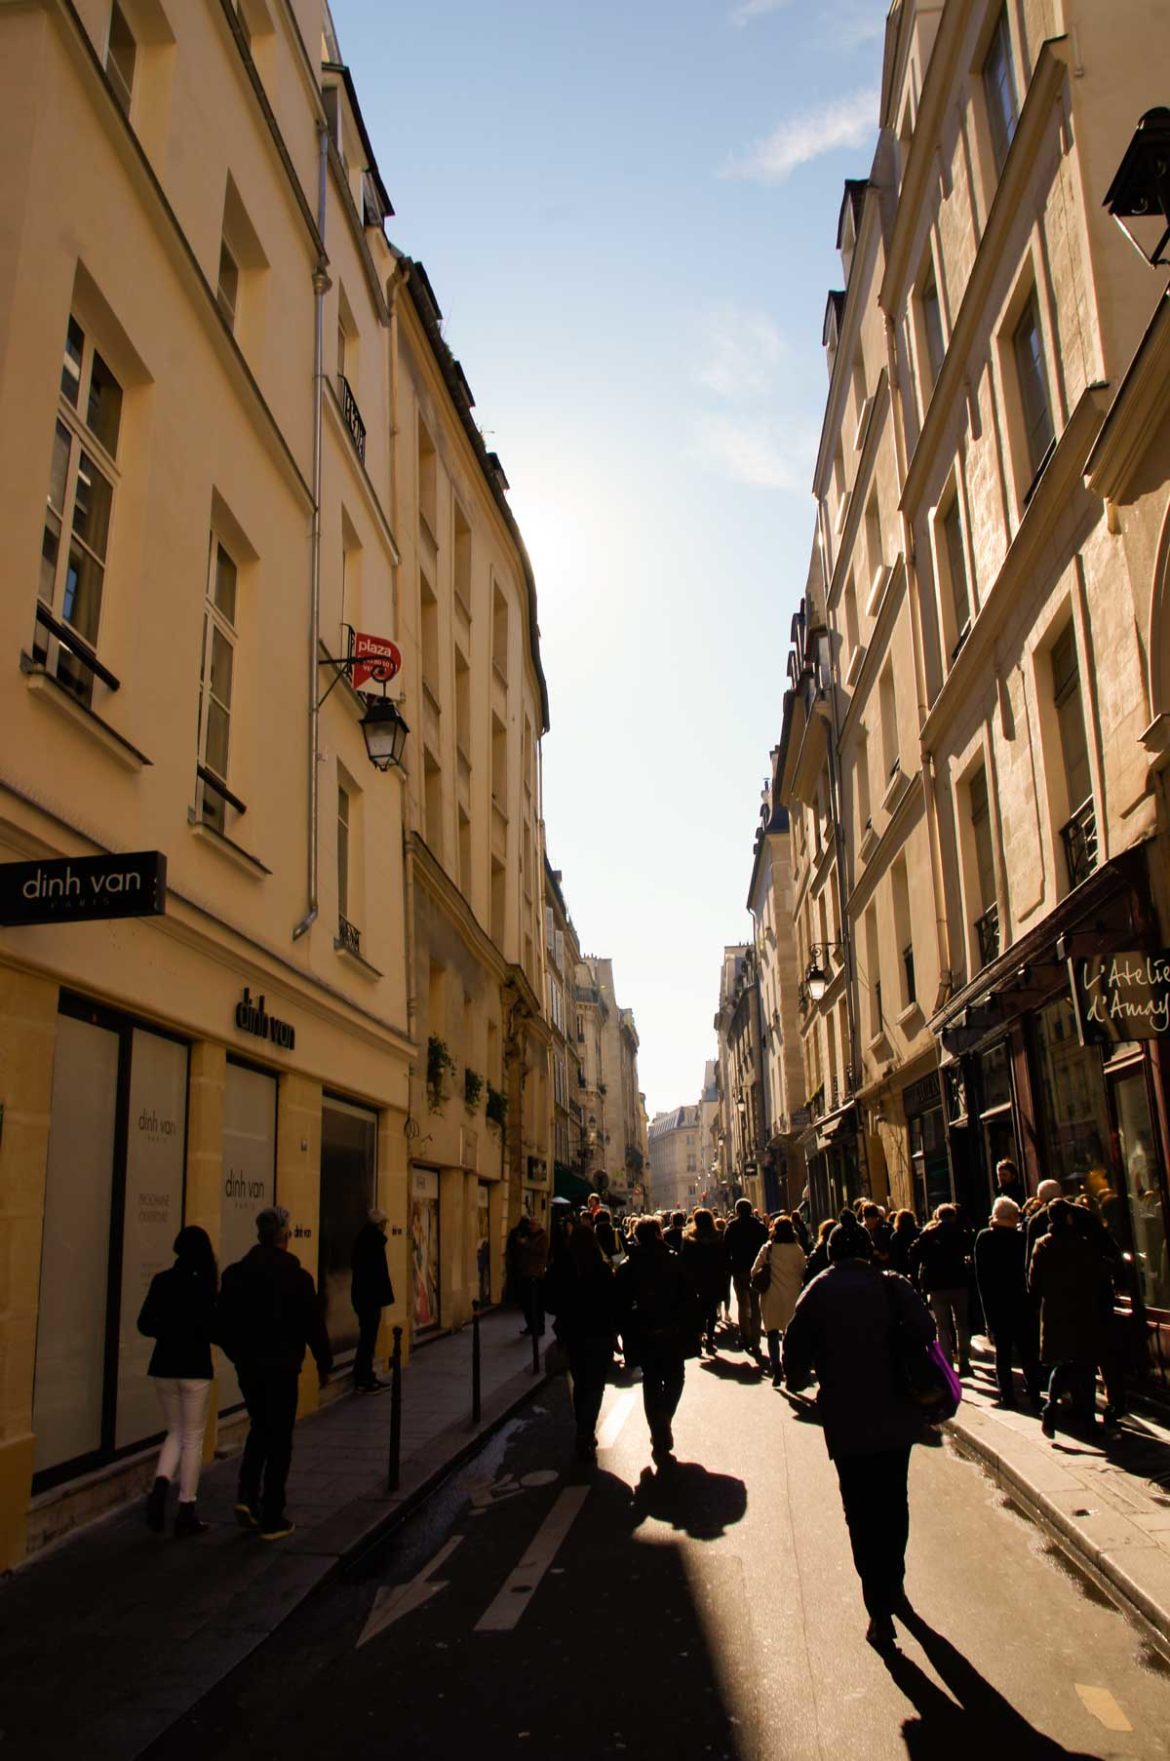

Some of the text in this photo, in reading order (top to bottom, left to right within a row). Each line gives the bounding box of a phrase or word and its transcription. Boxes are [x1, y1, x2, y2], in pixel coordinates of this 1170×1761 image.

[358, 639, 392, 657] plaza
[23, 866, 141, 898] dinh van
[235, 987, 295, 1050] dinh van
[138, 1108, 176, 1136] dinh van
[225, 1169, 265, 1200] dinh van
